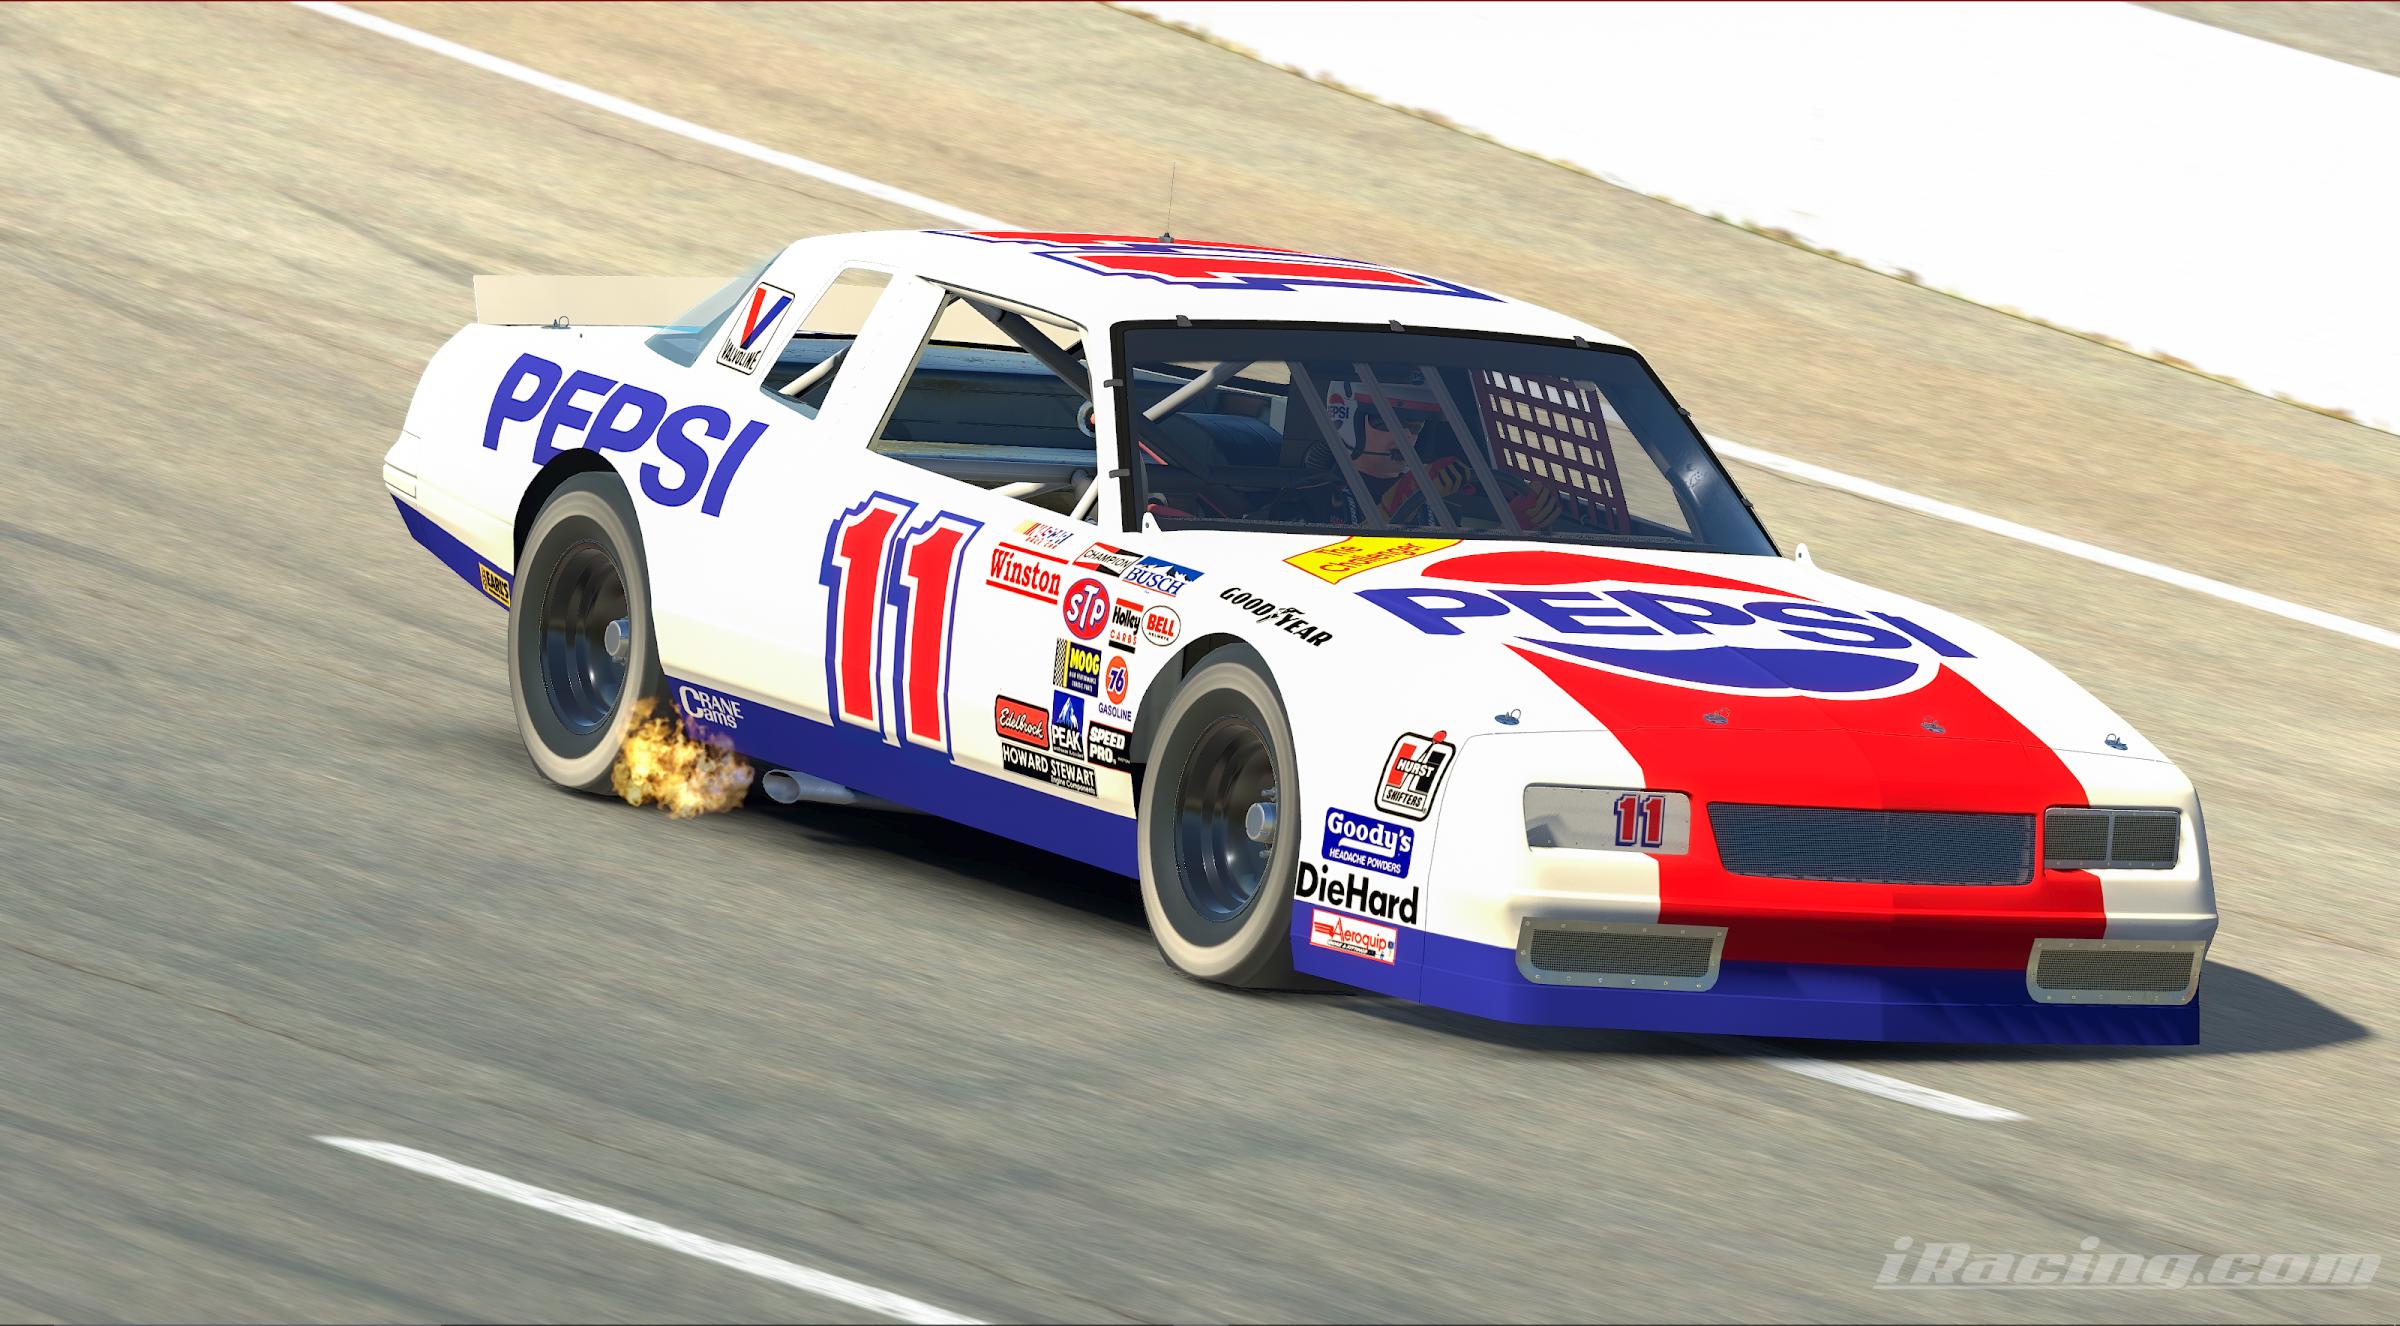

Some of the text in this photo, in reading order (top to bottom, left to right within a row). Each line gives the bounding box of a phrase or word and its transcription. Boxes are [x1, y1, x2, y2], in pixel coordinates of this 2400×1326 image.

[721, 338, 762, 370] VALVOLINE
[1328, 405, 1349, 419] EPSI
[482, 352, 770, 518] PEPSI
[990, 548, 1061, 596] Winston
[1083, 549, 1133, 568] CHAMPION
[1123, 567, 1187, 595] BUSCH
[1066, 584, 1106, 629] STP
[1112, 605, 1141, 636] Holley
[818, 490, 986, 762] 11
[1110, 628, 1137, 646] CARBS
[1146, 613, 1175, 637] BELL
[1354, 587, 1977, 658] PEPSI
[1069, 647, 1100, 676] MOOG
[1108, 667, 1125, 693] 76
[679, 685, 744, 719] CRANE
[1098, 702, 1132, 721] GASOLINE
[999, 707, 1045, 739] Edelbrock
[1051, 724, 1083, 752] PEAK
[1089, 725, 1126, 750] SPEED
[1002, 744, 1049, 773] HOWARD
[1050, 759, 1095, 787] STEWART
[1396, 758, 1435, 779] HURST
[1386, 788, 1423, 807] SHIFTERS
[1327, 812, 1411, 852] Goody's
[1614, 793, 1665, 848] 11
[1328, 848, 1402, 874] HEADACHE POWDERS
[1296, 861, 1419, 925] DieHard
[1332, 917, 1387, 952] Aeroquip
